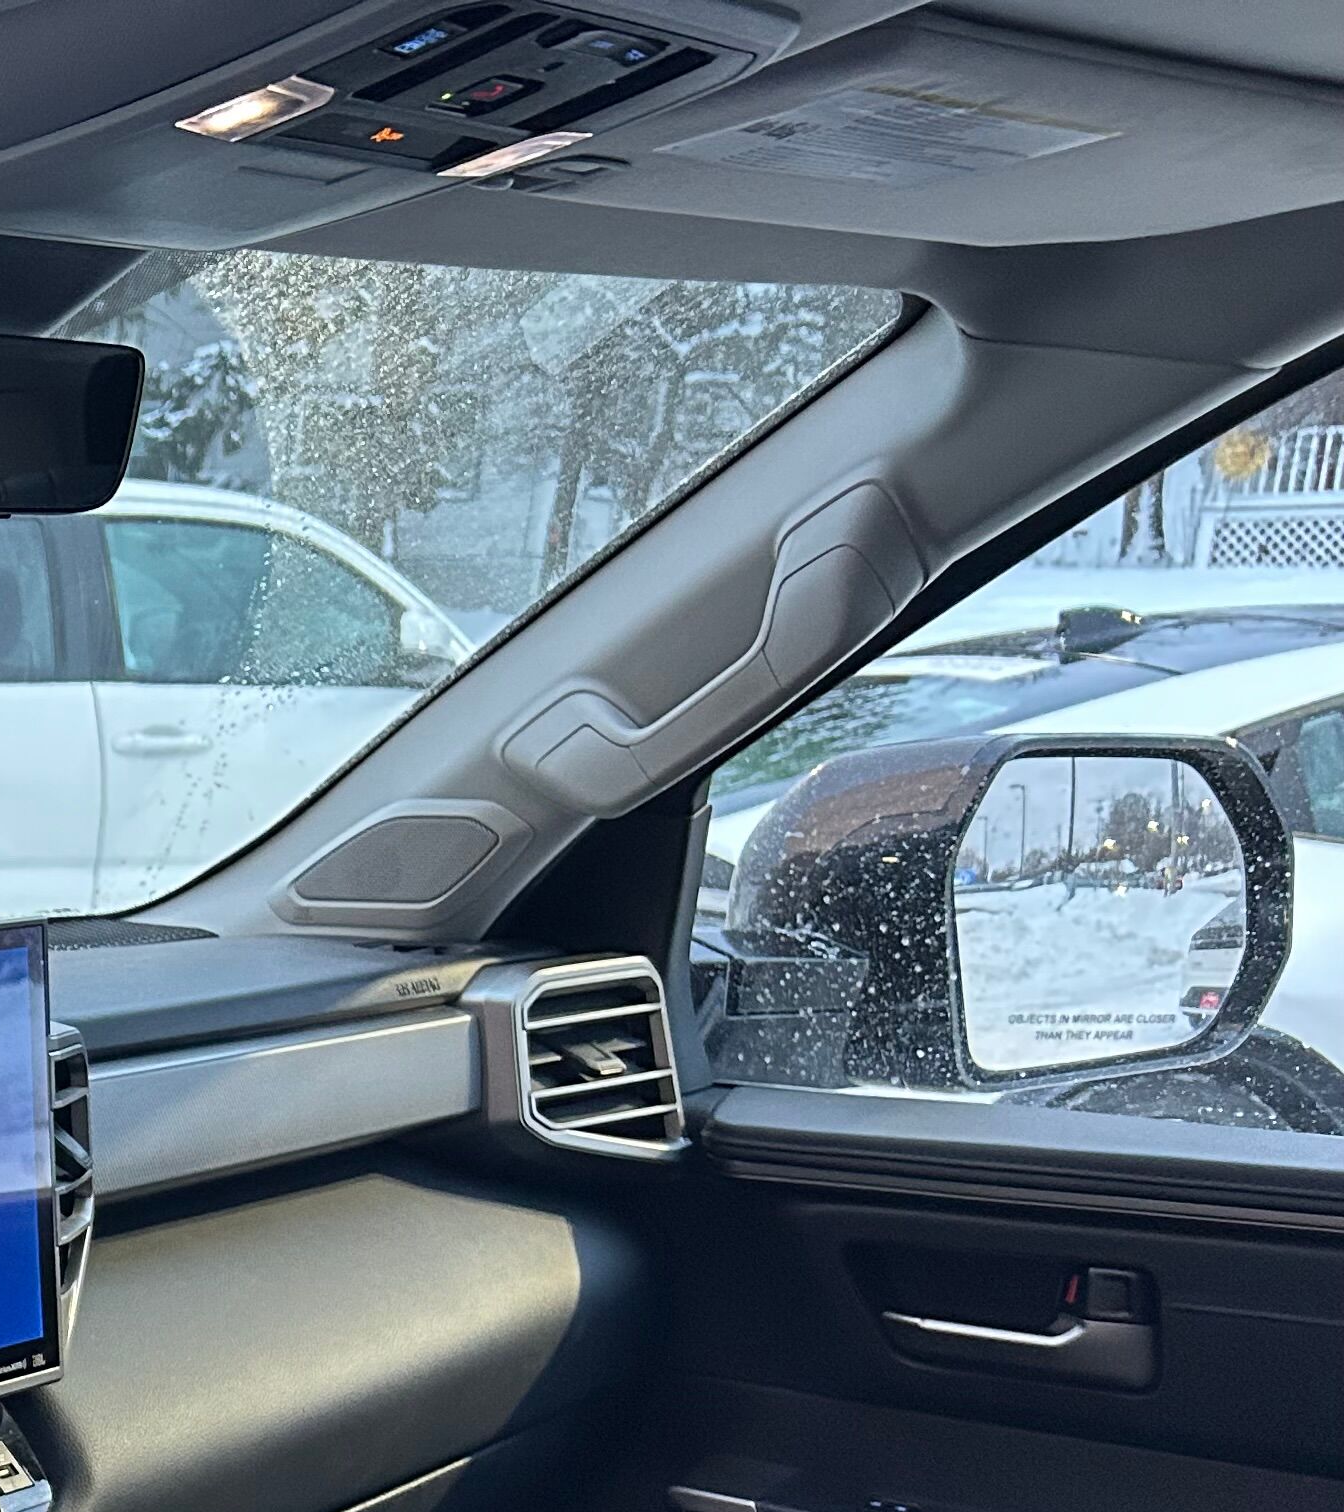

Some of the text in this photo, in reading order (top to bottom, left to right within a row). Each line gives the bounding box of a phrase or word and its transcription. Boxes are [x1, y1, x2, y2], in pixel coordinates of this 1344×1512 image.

[1008, 1014, 1176, 1024] OBJECTS IN MIRROR ARE CLOSER
[1035, 1030, 1134, 1040] THAN THEY APPEAR
